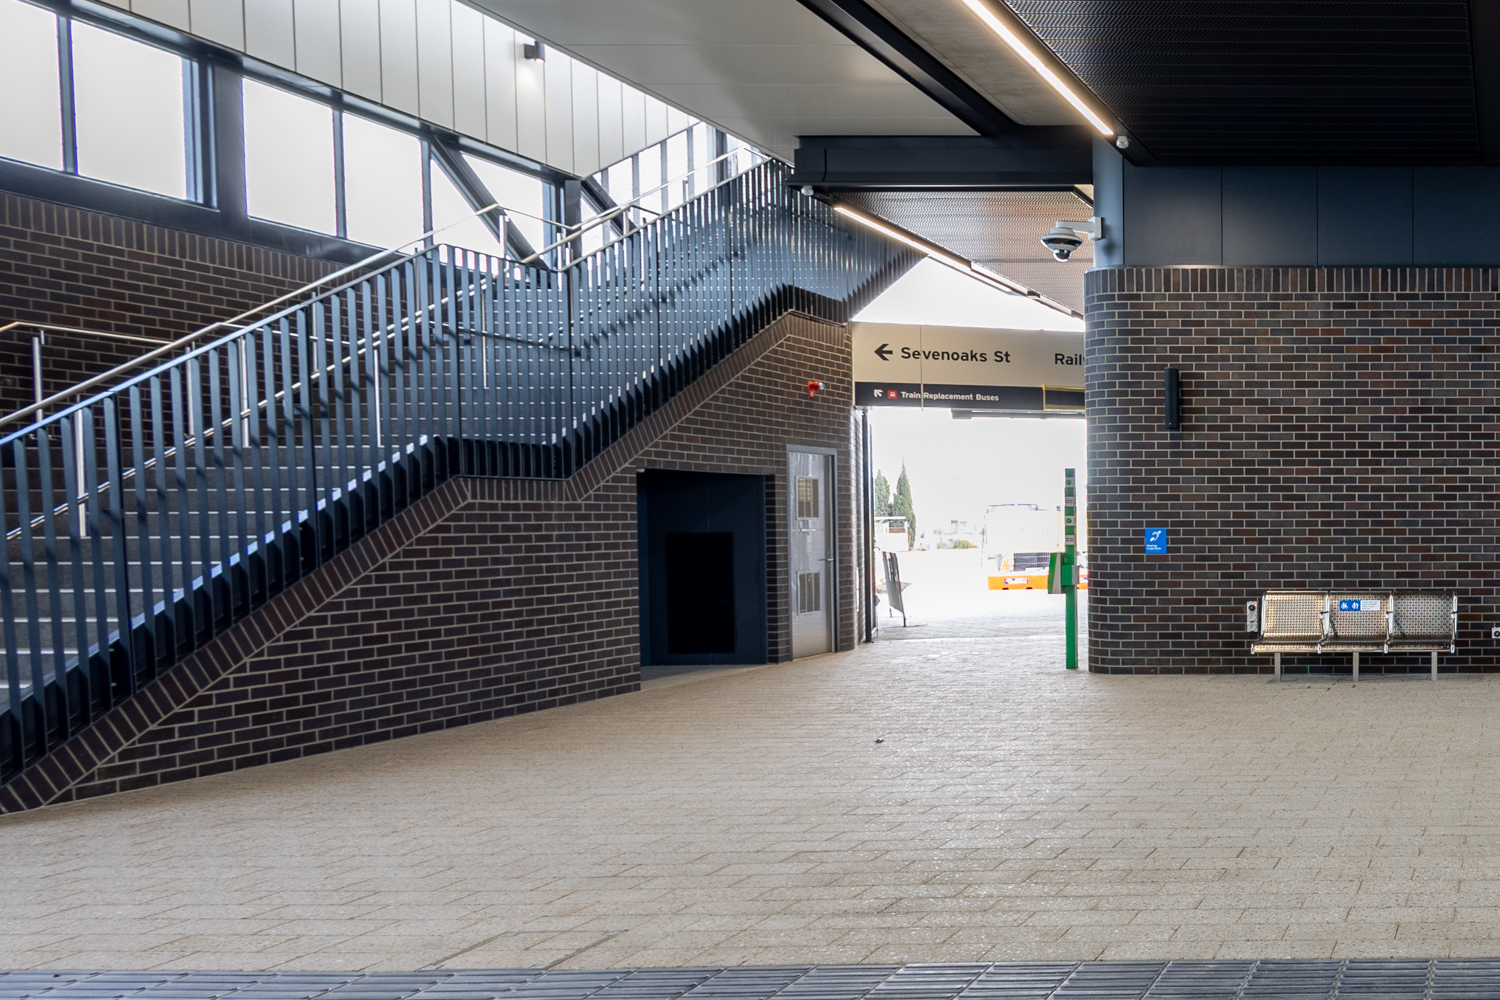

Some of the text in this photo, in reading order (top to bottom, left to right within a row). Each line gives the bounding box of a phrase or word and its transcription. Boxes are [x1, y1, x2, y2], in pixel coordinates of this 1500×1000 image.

[901, 346, 1011, 363] Sevenoaks St
[1054, 353, 1085, 366] Rail
[901, 391, 1000, 402] Train Replacement Buses
